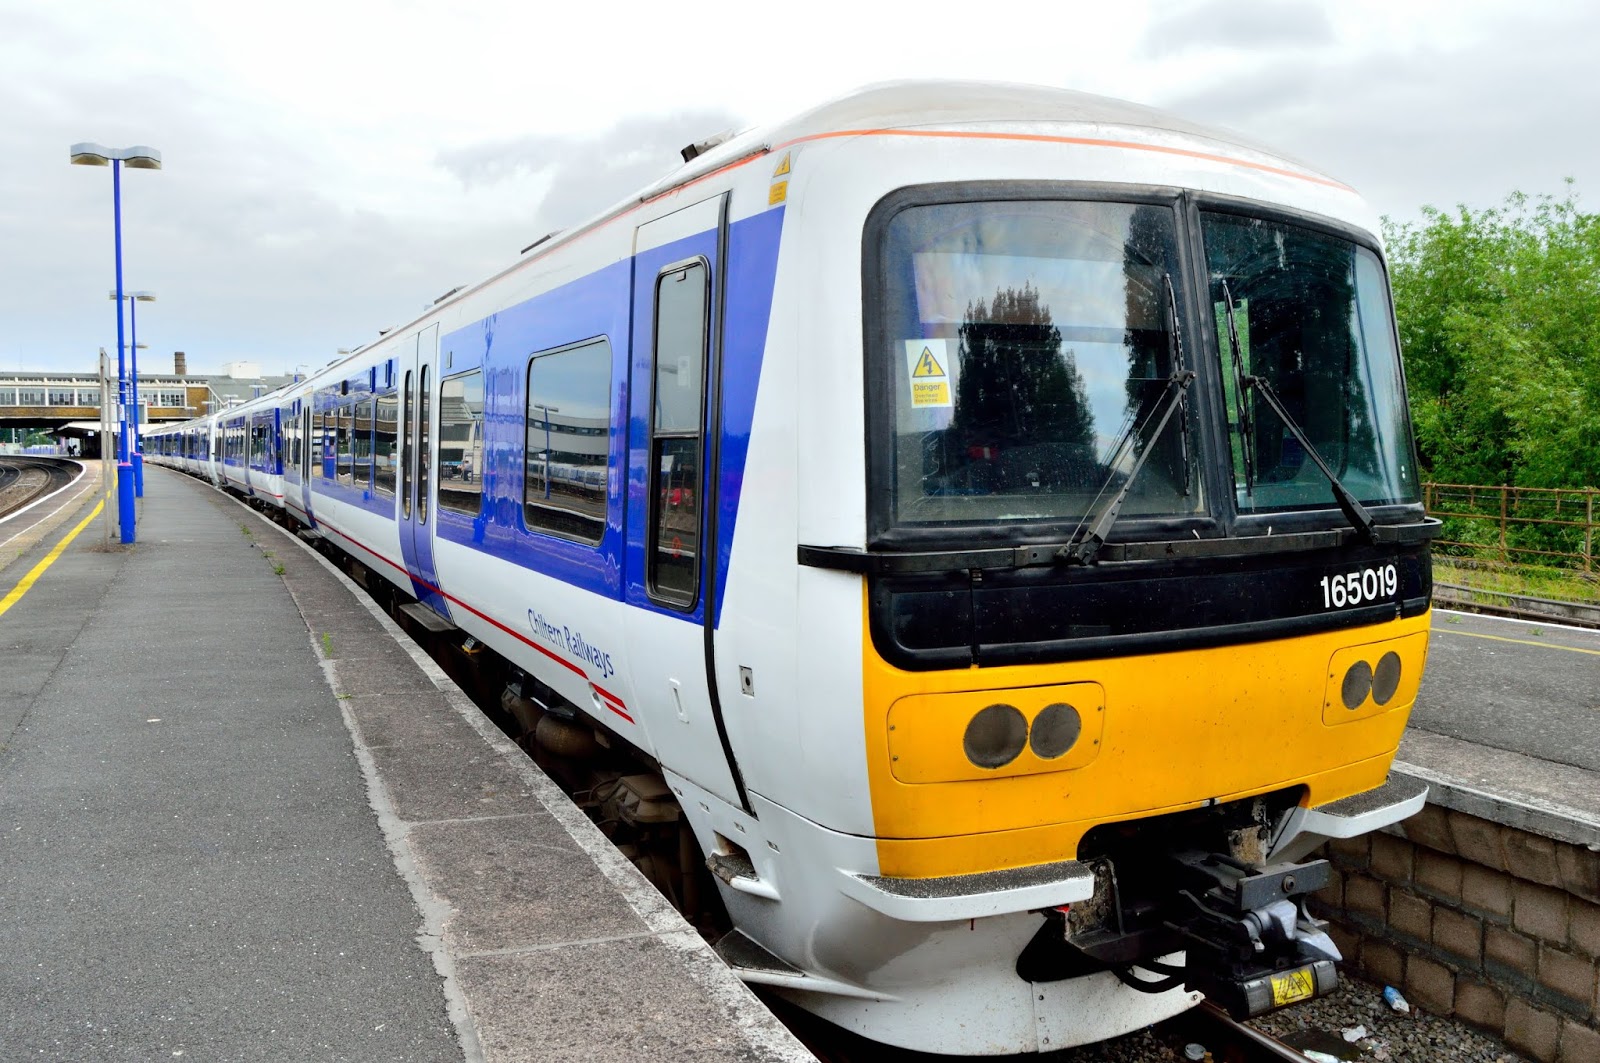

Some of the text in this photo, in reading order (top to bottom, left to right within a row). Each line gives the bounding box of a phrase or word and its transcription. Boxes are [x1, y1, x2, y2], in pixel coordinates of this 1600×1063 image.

[914, 384, 941, 392] Danger
[1320, 564, 1398, 608] 165019
[527, 608, 614, 679] Chiltern Railways
